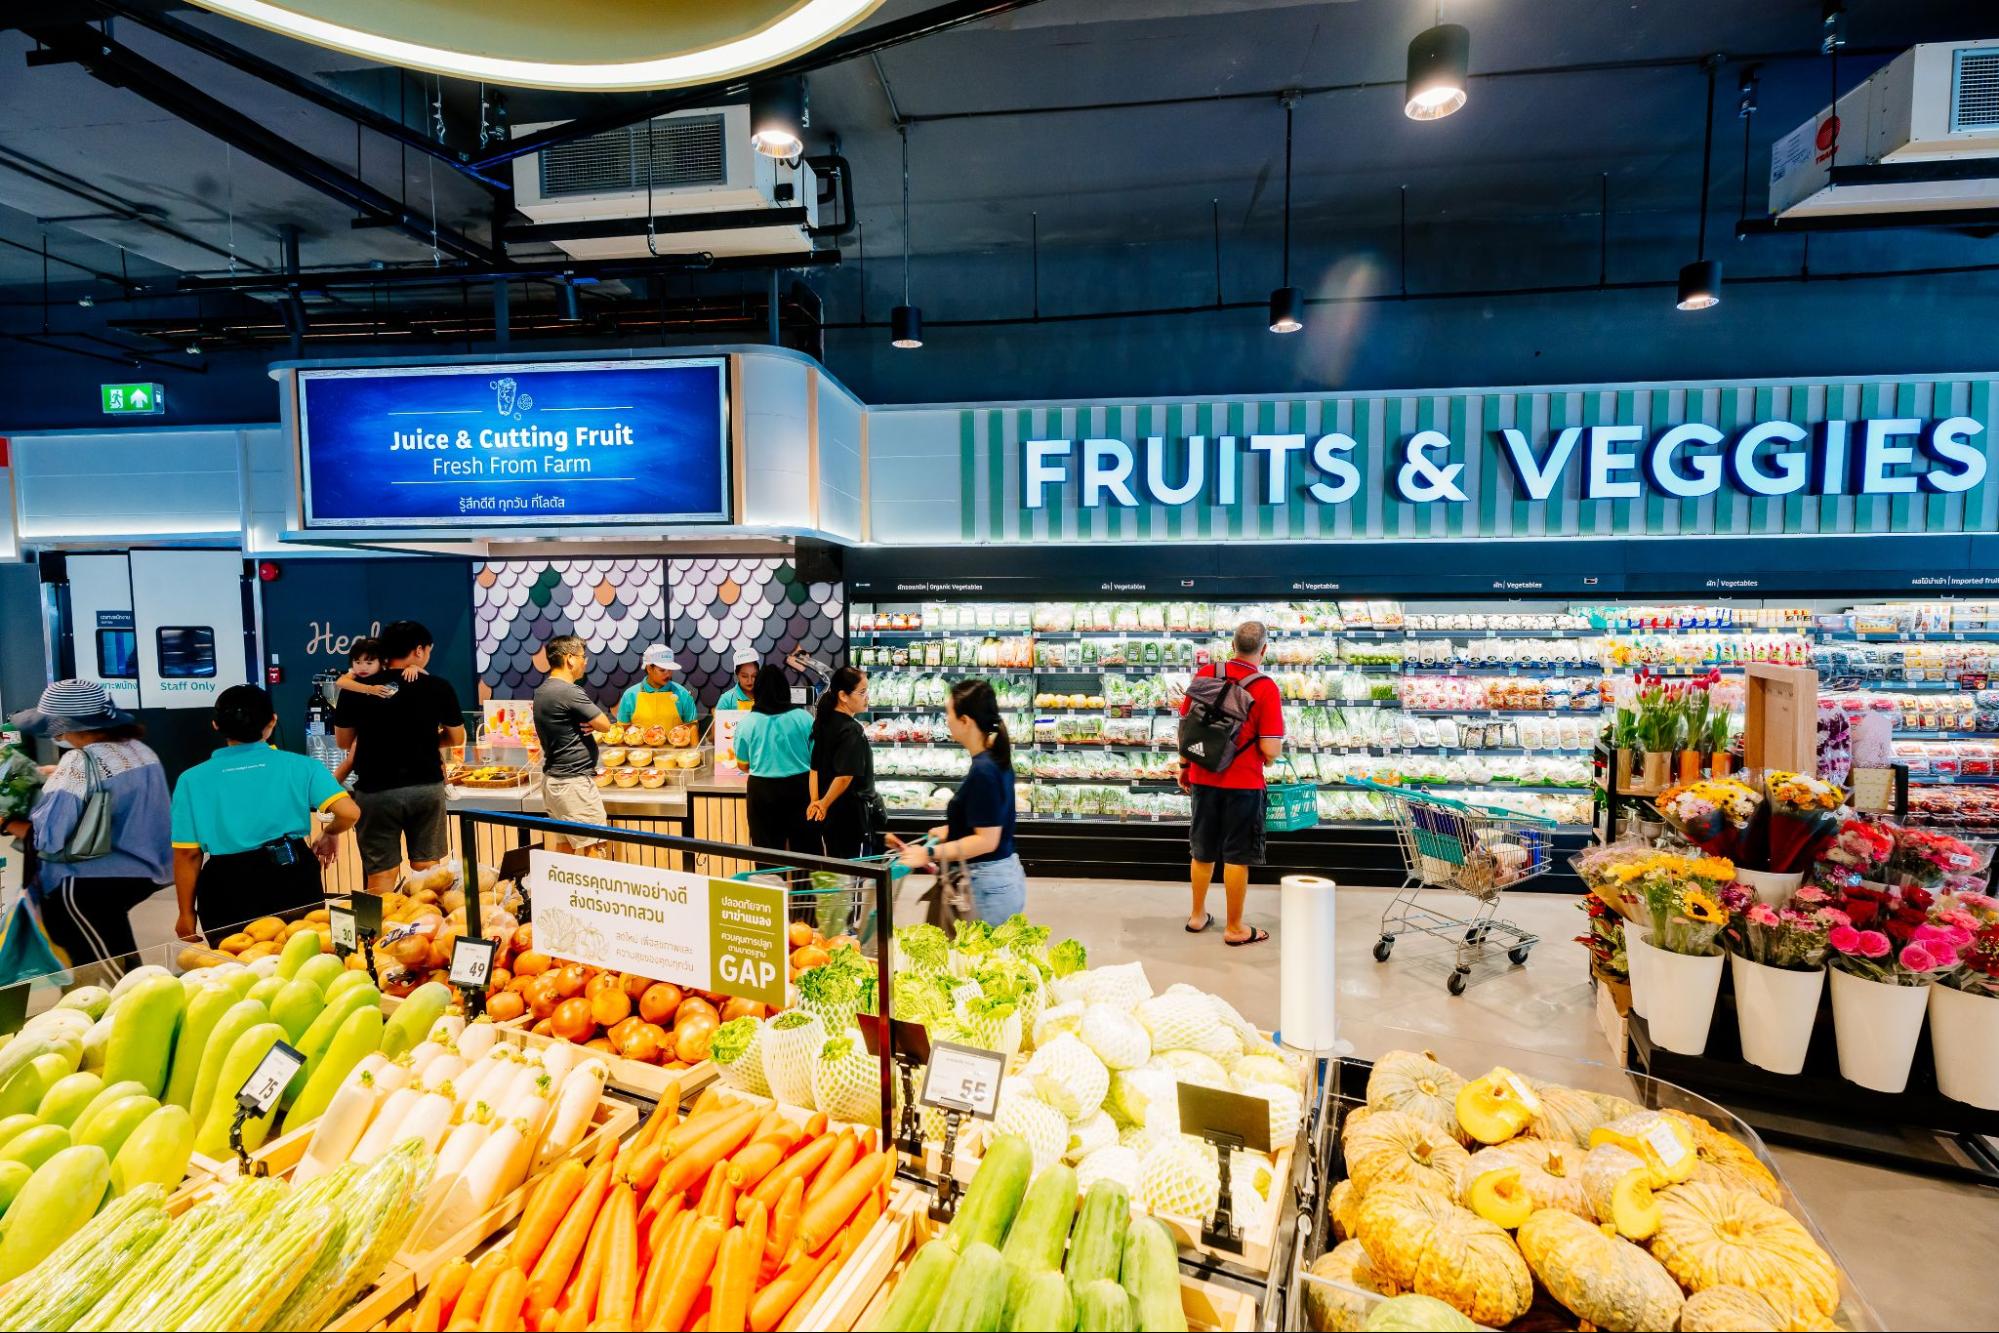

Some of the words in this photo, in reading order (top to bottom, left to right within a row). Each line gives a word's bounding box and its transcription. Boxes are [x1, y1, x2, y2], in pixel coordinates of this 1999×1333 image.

[390, 428, 449, 452] Juice
[456, 430, 473, 450] &
[480, 425, 568, 452] Cutting
[576, 423, 634, 447] Fruit
[434, 457, 484, 475] Fresh
[490, 456, 537, 474] From
[544, 455, 592, 473] Farm
[1025, 433, 1361, 509] FRUITS
[1397, 430, 1470, 502] &
[1502, 416, 1988, 500] VEGGIES
[499, 496, 528, 512] ทุกวัน
[531, 493, 565, 509] ที่โลตัส
[952, 583, 982, 591] Vegetables
[1114, 583, 1146, 591] Vegetables
[1305, 582, 1339, 591] Vegetables
[1506, 581, 1543, 590] Vegetables
[1720, 579, 1758, 588] Vegetables
[1951, 577, 1984, 586] Imported
[160, 681, 187, 691] Staff
[190, 681, 217, 692] Only
[548, 865, 688, 905] คัดสรรคุณภาพอย่างดี
[569, 891, 665, 924] ส่งตรงจากสวน
[343, 927, 353, 942] 30
[469, 962, 486, 978] 49
[719, 954, 777, 990] GAP
